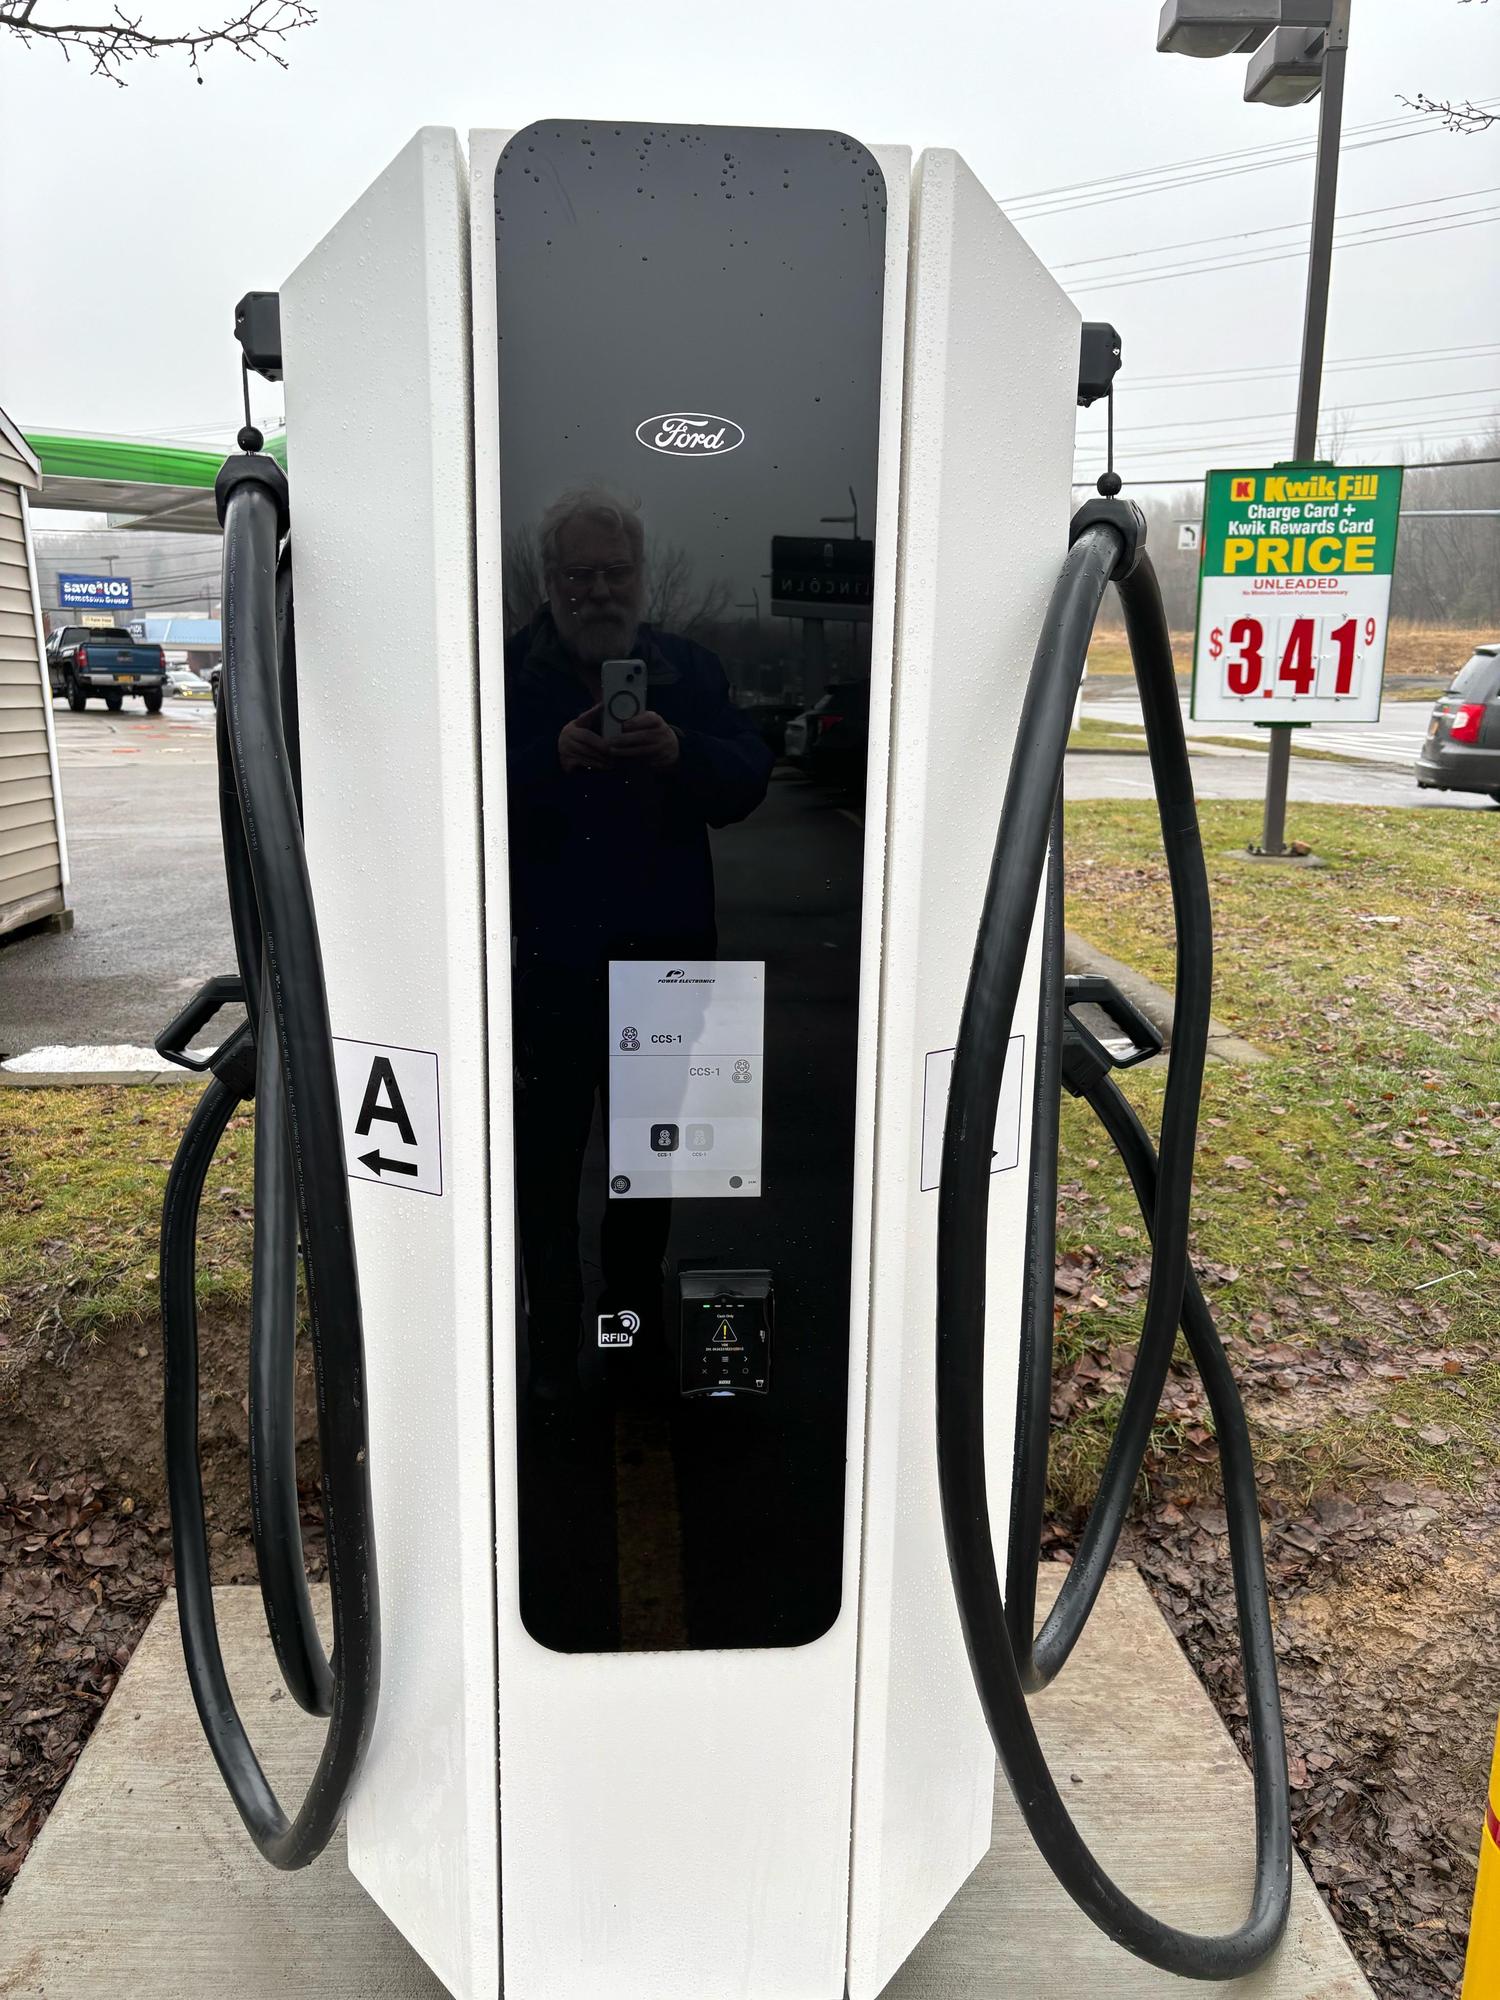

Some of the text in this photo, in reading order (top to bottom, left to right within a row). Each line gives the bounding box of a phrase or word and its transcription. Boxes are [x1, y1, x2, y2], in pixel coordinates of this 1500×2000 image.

[653, 416, 728, 450] Ford
[1234, 474, 1379, 503] K Kwik Fill
[1247, 502, 1357, 522] Charge Card +
[1228, 518, 1375, 536] Kwik Rewards Card
[1222, 536, 1377, 575] PRICE
[1253, 578, 1339, 590] UNLEADED
[650, 1034, 682, 1044] CCS-1
[689, 1067, 721, 1077] CCS-1
[354, 1055, 419, 1146] A
[601, 1333, 629, 1343] RFID
